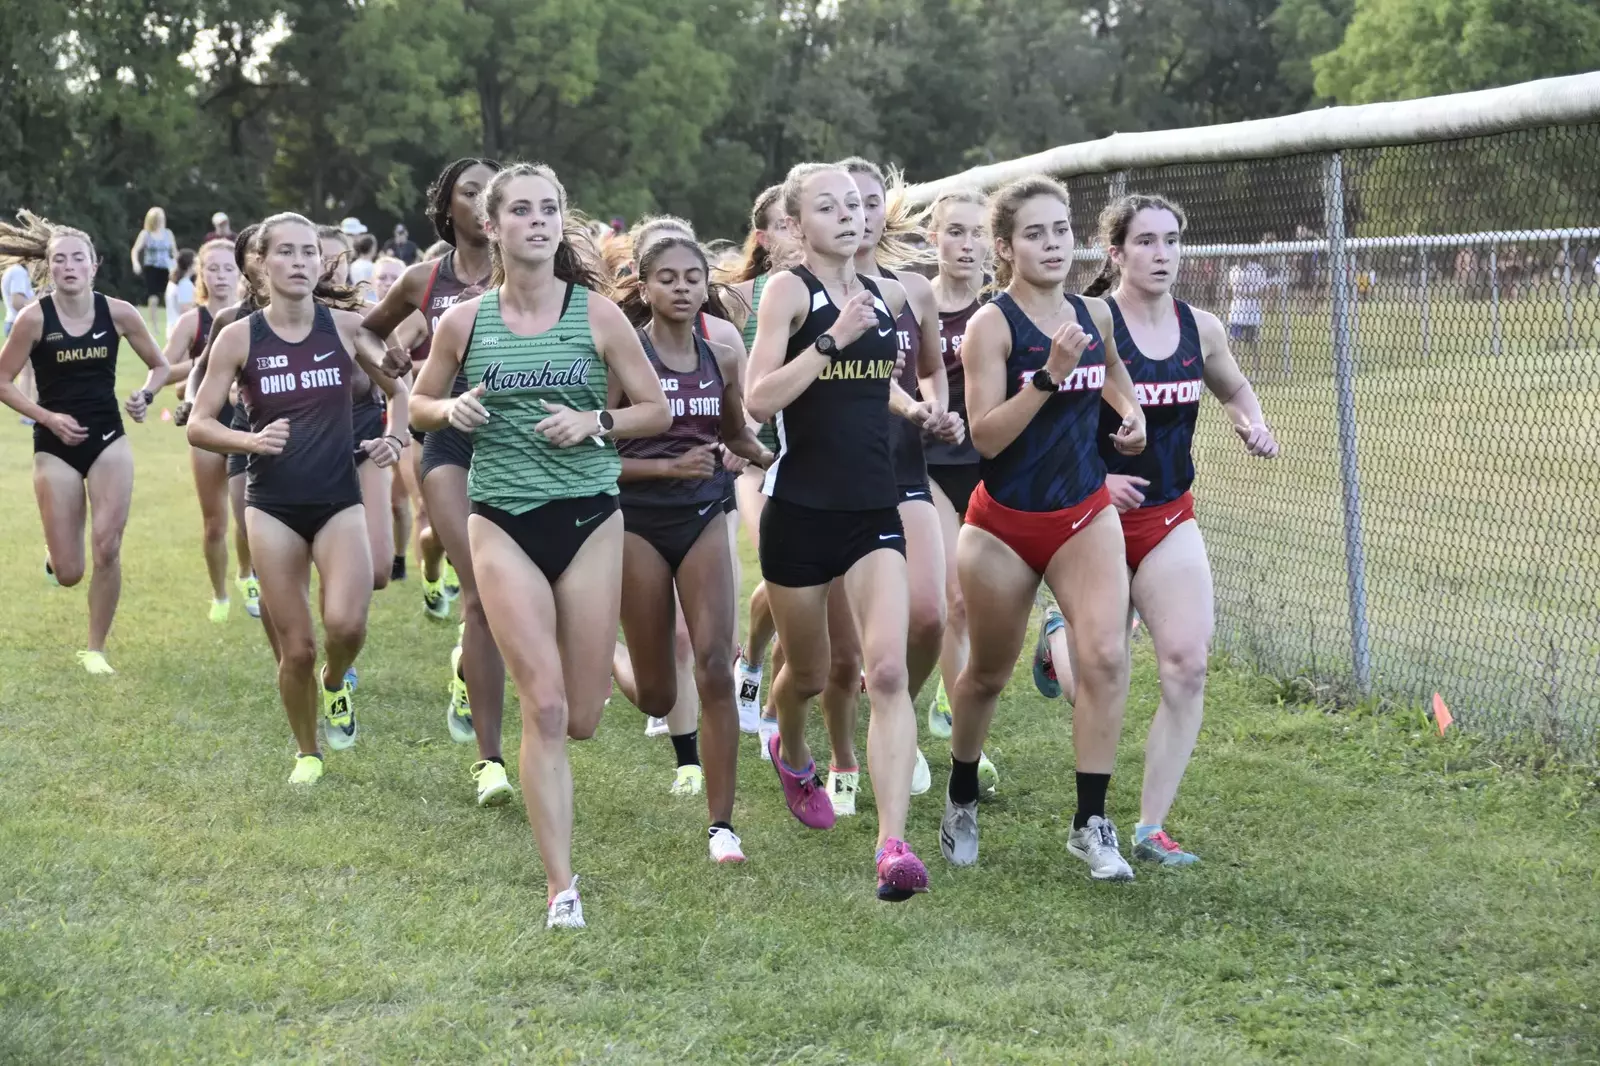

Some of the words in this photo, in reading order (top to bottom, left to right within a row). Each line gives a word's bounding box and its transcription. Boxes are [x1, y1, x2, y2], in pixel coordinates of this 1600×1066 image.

[56, 346, 108, 363] OAKLAND
[260, 372, 296, 395] OHIO
[300, 367, 342, 389] STATE
[481, 357, 592, 392] Marshall
[1018, 364, 1106, 393] YTON
[1133, 379, 1201, 406] AYTON
[689, 397, 720, 416] STATE
